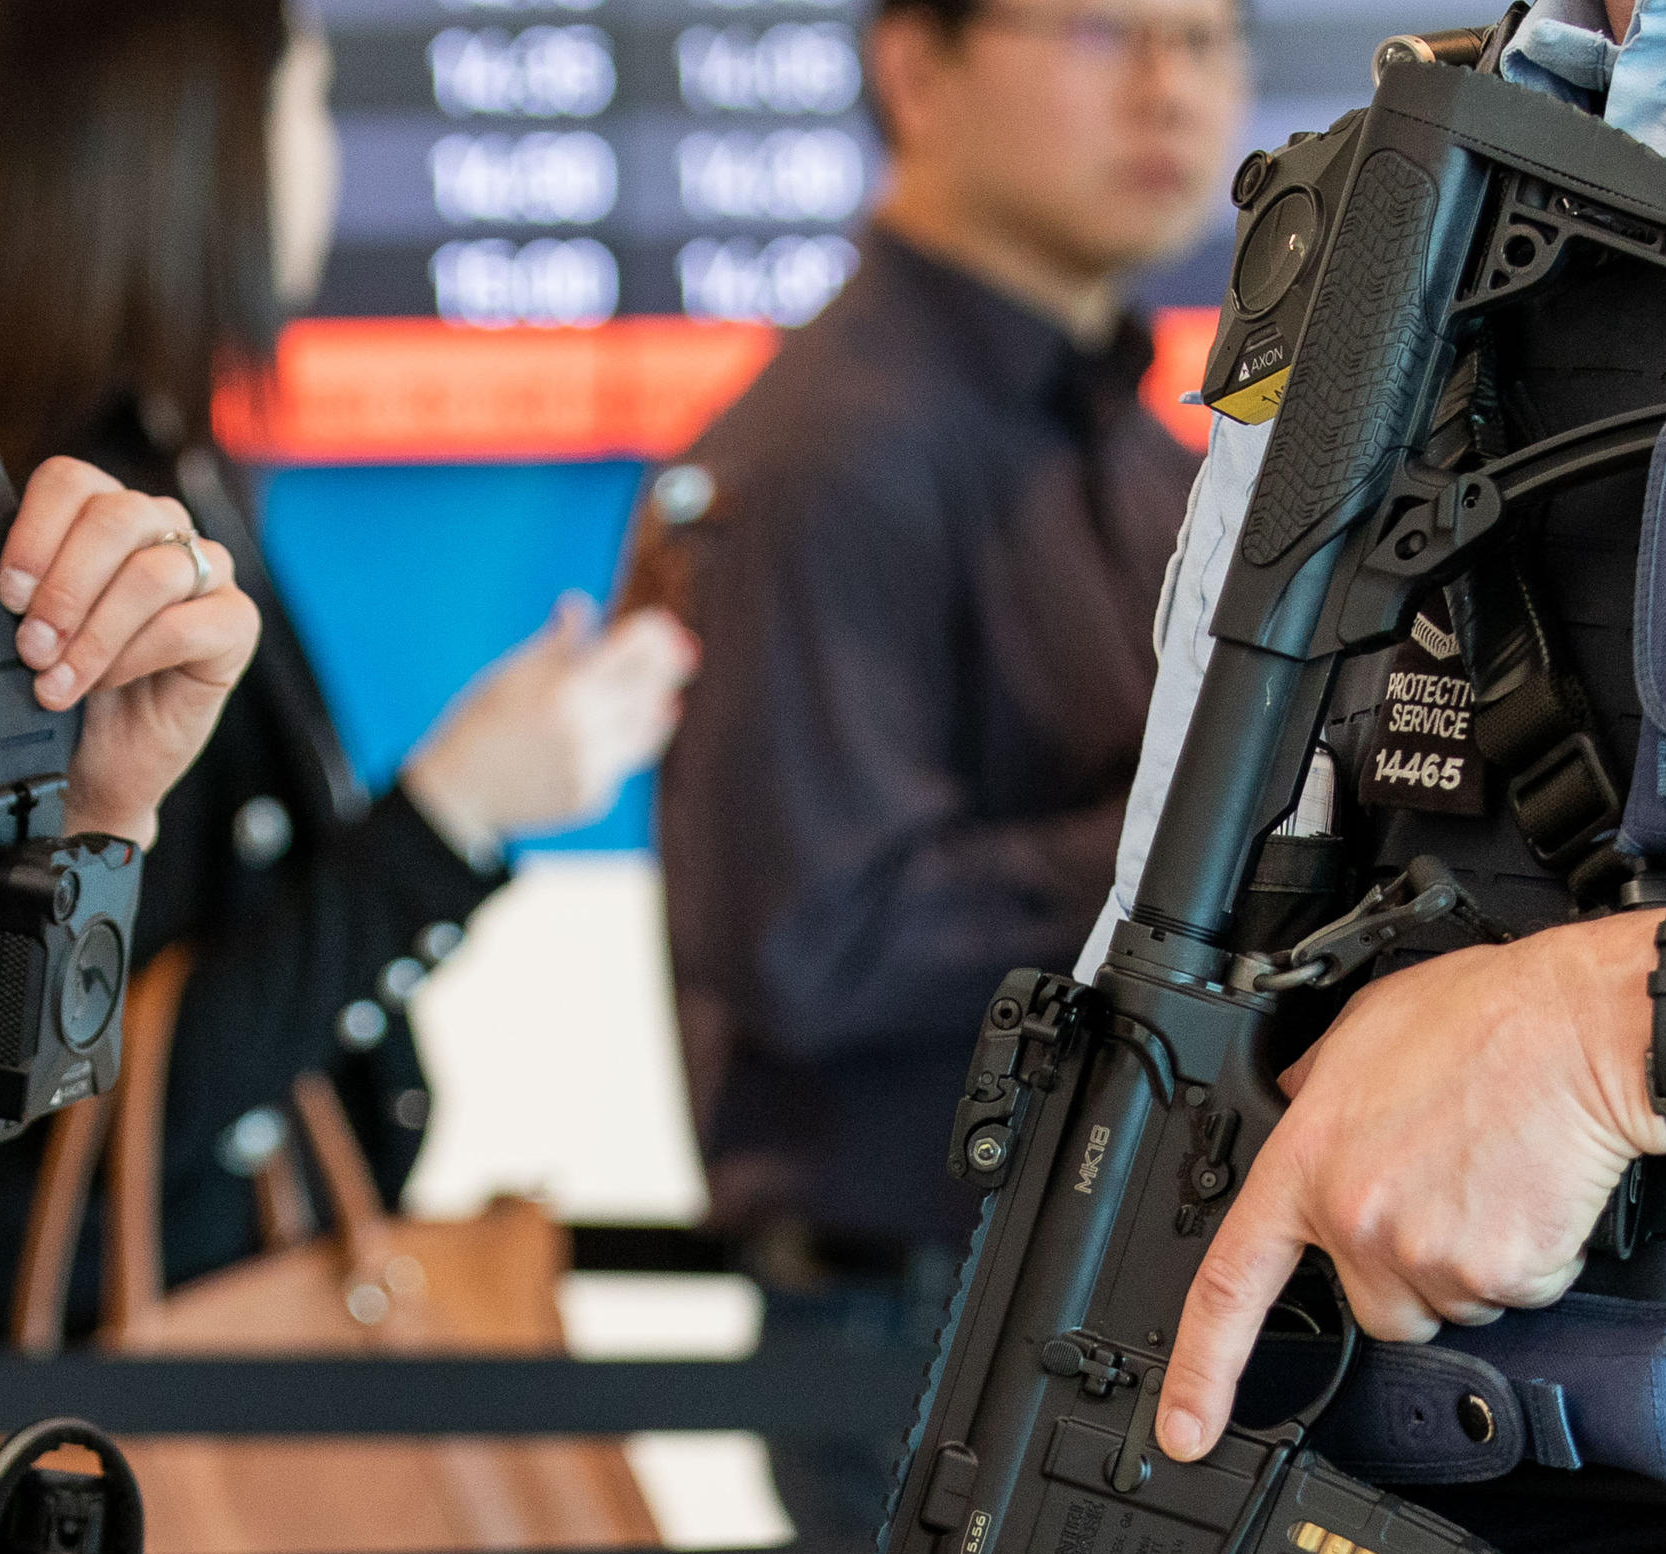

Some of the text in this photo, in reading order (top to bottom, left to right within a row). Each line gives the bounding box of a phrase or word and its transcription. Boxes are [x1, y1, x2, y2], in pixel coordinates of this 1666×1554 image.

[1252, 345, 1283, 372] AXON
[1386, 672, 1475, 707] PROTECTI
[1388, 703, 1471, 740] SERVICE
[1374, 748, 1464, 790] 14465
[1074, 1124, 1110, 1194] MK18
[966, 1514, 987, 1553] 5.56
